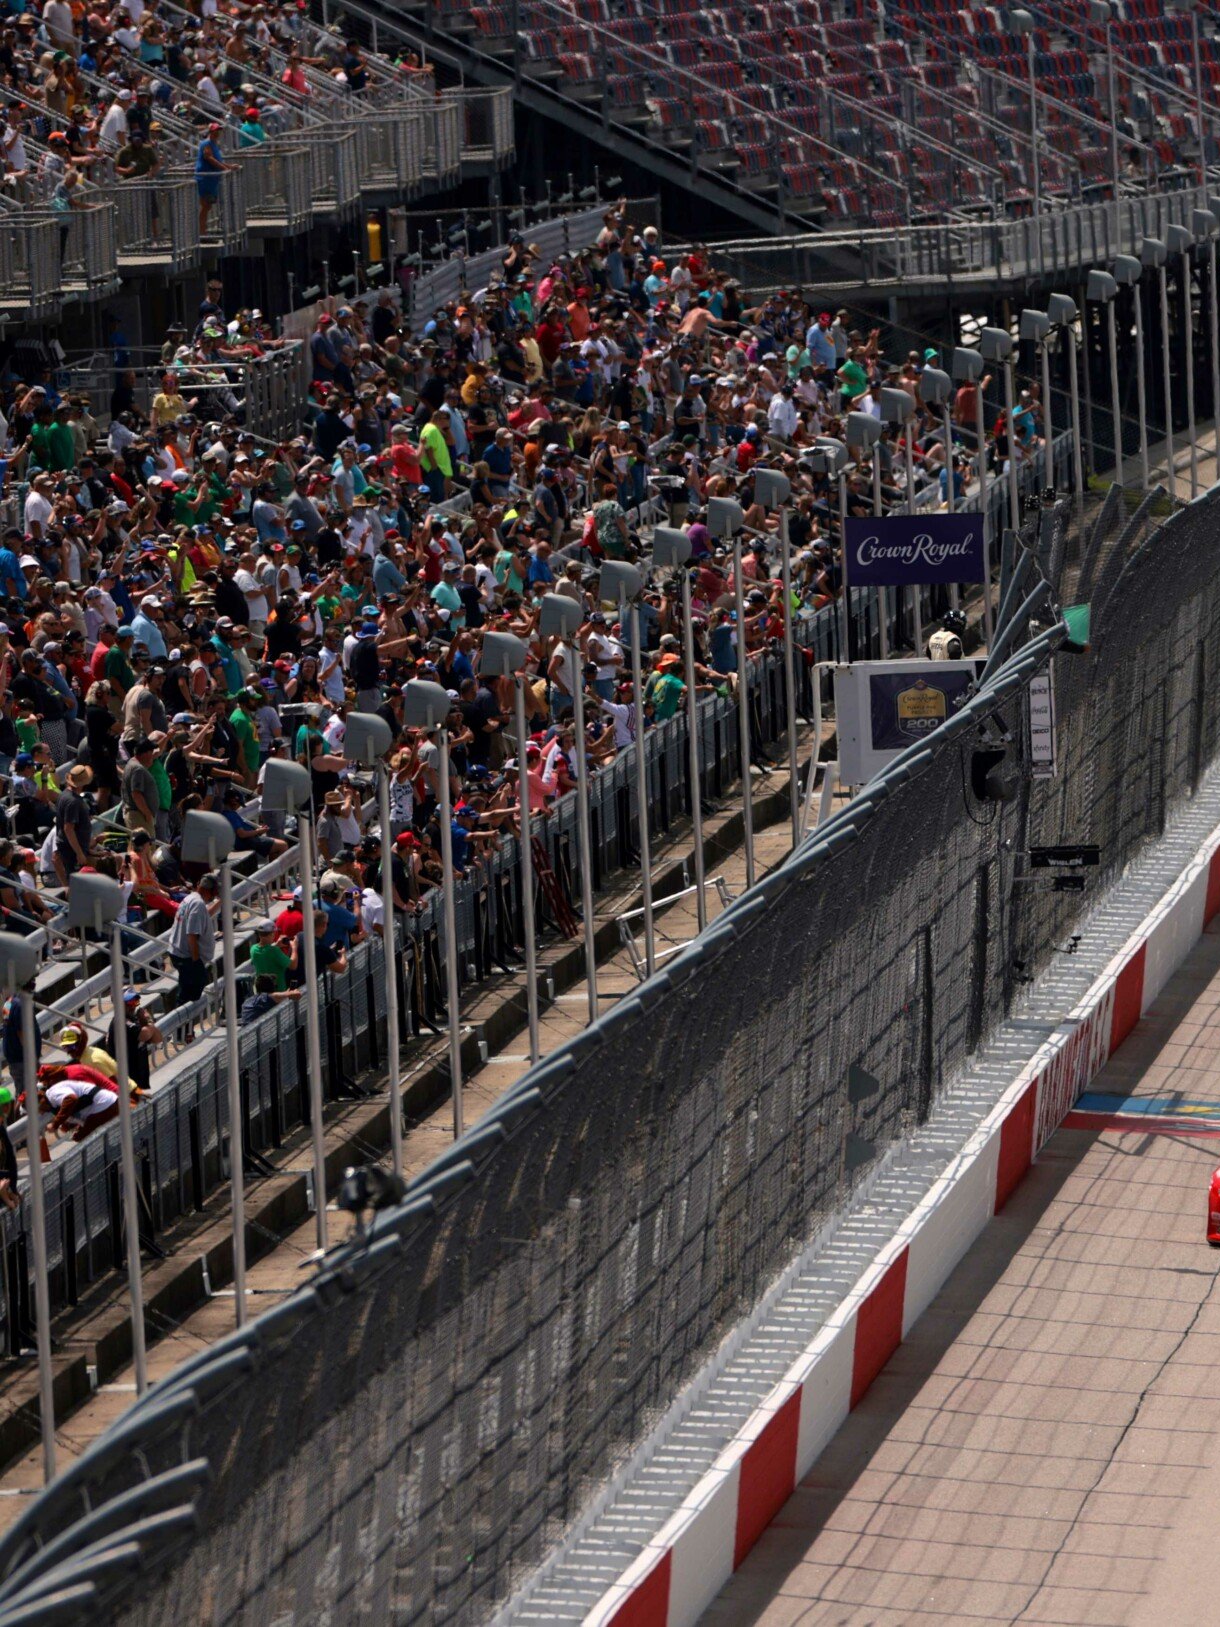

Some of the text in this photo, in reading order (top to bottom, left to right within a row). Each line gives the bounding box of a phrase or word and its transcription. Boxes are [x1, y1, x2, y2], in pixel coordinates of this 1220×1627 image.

[857, 533, 974, 566] Crown Royal
[907, 719, 938, 729] 200
